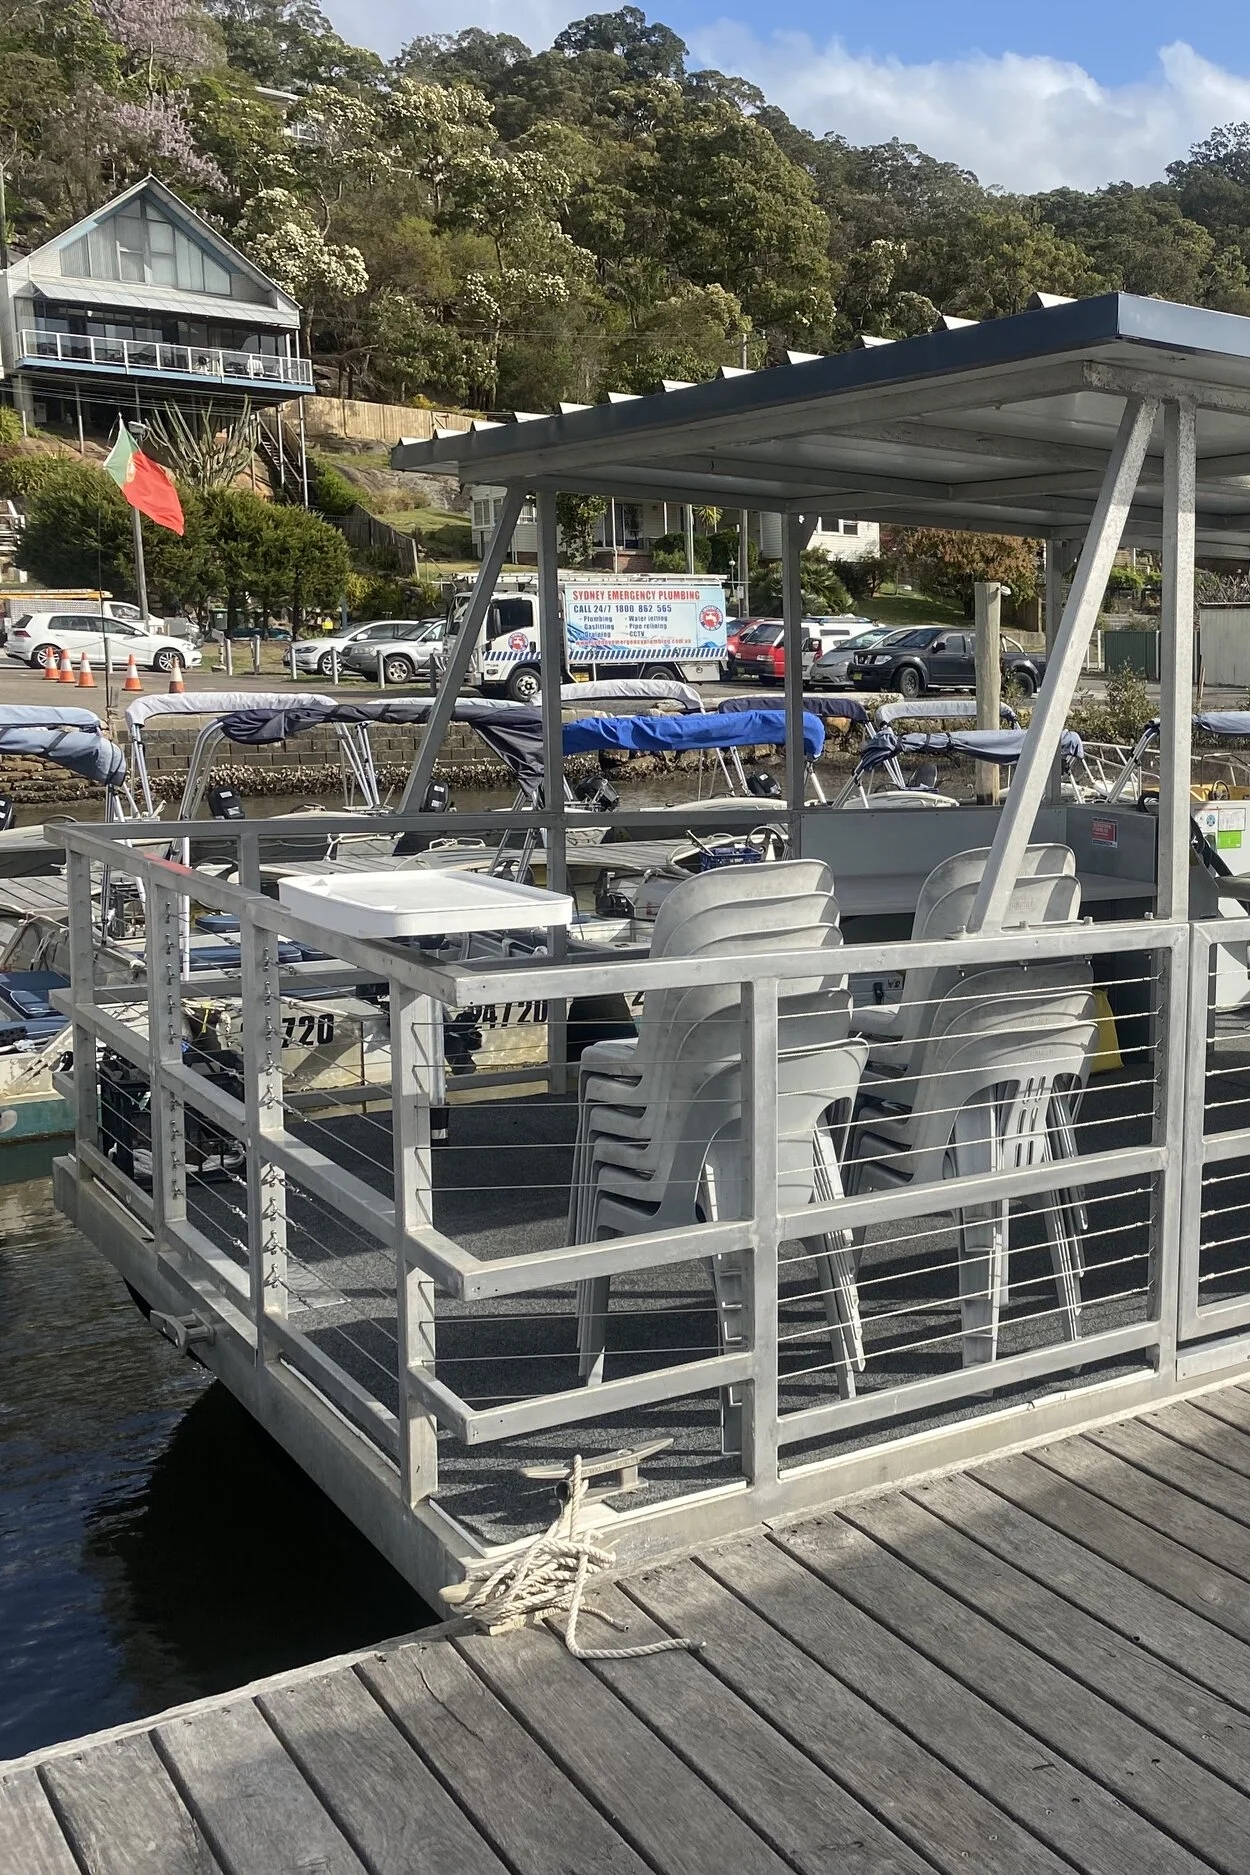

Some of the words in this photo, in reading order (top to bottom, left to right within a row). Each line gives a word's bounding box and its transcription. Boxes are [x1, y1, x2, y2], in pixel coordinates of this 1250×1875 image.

[572, 590, 605, 601] SYDNEY
[607, 590, 656, 601] EMERGENCY
[658, 590, 700, 600] PLUMBING
[573, 604, 592, 613] CALL
[593, 604, 612, 613] 24/7
[615, 604, 635, 613] 1800
[638, 604, 653, 613] 862
[656, 604, 672, 613] 565
[583, 615, 613, 623] Plumbing
[629, 630, 645, 638] CCTV
